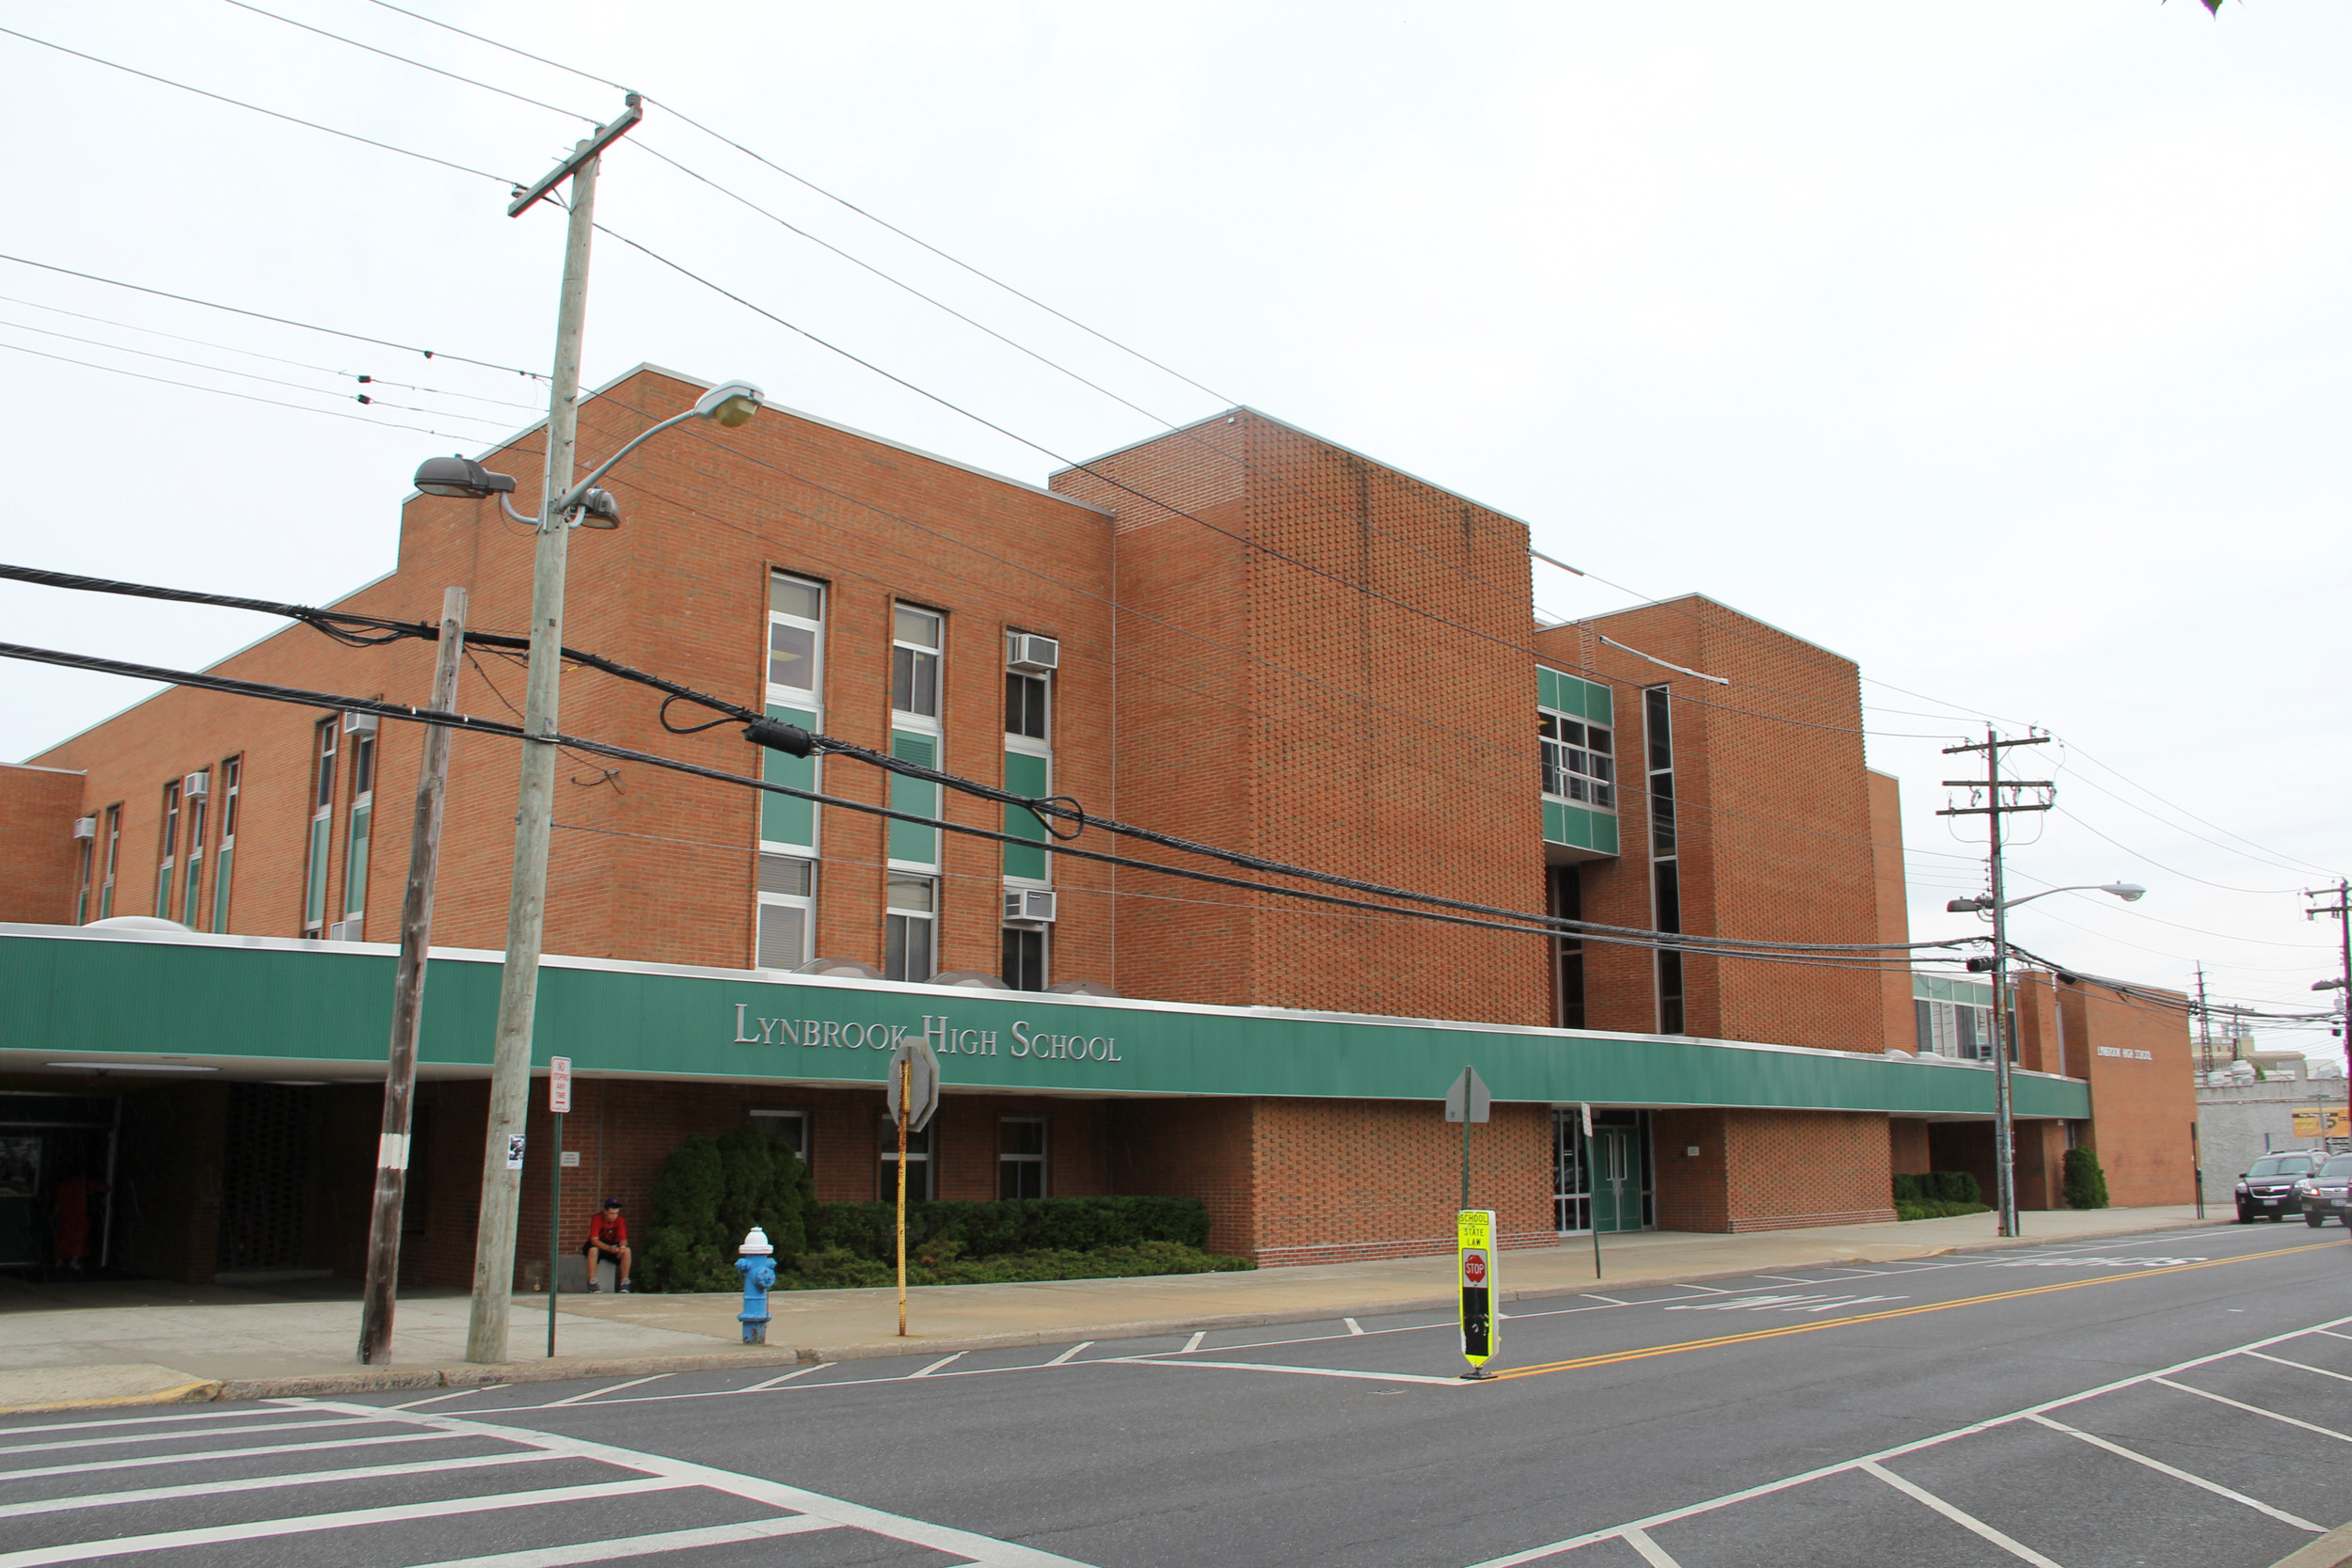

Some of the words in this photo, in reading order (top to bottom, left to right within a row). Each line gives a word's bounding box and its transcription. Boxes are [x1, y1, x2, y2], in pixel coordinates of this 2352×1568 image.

[734, 1004, 908, 1052] LYNBROOK
[922, 1015, 997, 1056] HIGH
[1010, 1021, 1121, 1062] SCHOOL
[1460, 1214, 1488, 1223] SCHOOL
[1466, 1263, 1484, 1274] STOP
